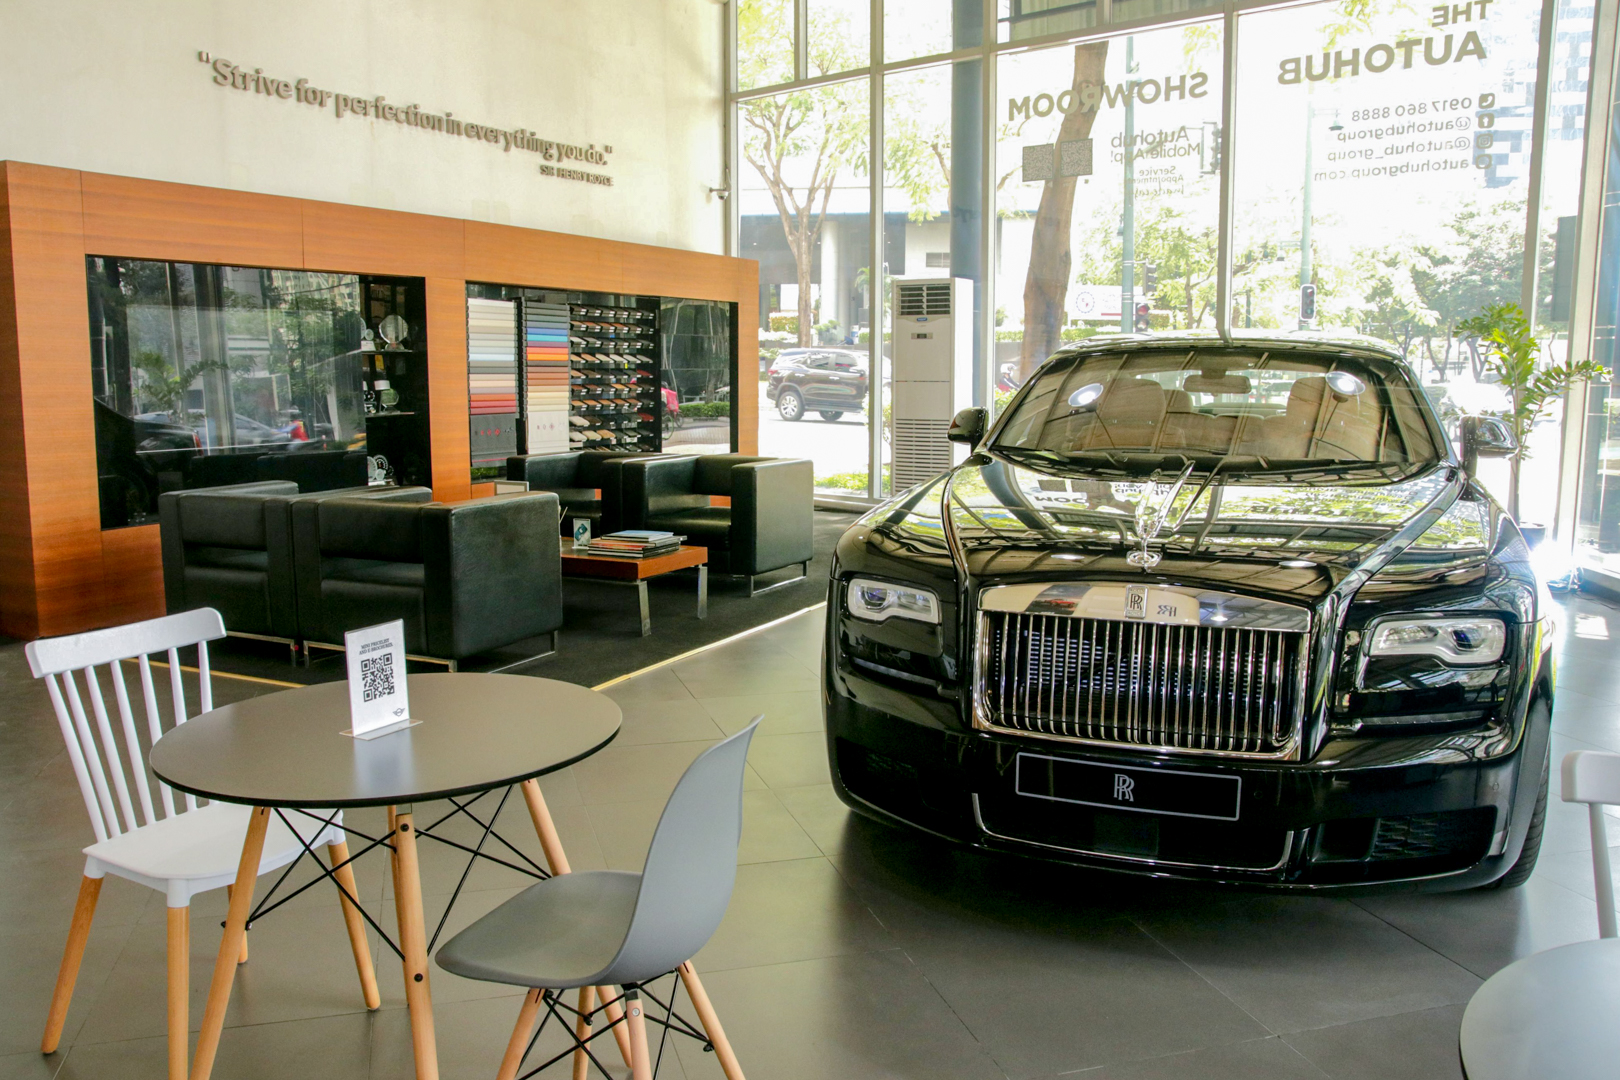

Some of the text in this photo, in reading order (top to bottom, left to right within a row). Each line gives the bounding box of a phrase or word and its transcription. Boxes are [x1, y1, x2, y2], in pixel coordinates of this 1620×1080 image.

[197, 50, 293, 99] "Strive
[295, 78, 332, 108] for
[335, 93, 445, 131] perfection
[445, 111, 463, 136] in
[464, 122, 555, 161] everything
[556, 142, 585, 163] you
[540, 164, 614, 187] SIR HENRY ROYCE
[1130, 593, 1143, 611] RR
[1113, 773, 1135, 802] RR
